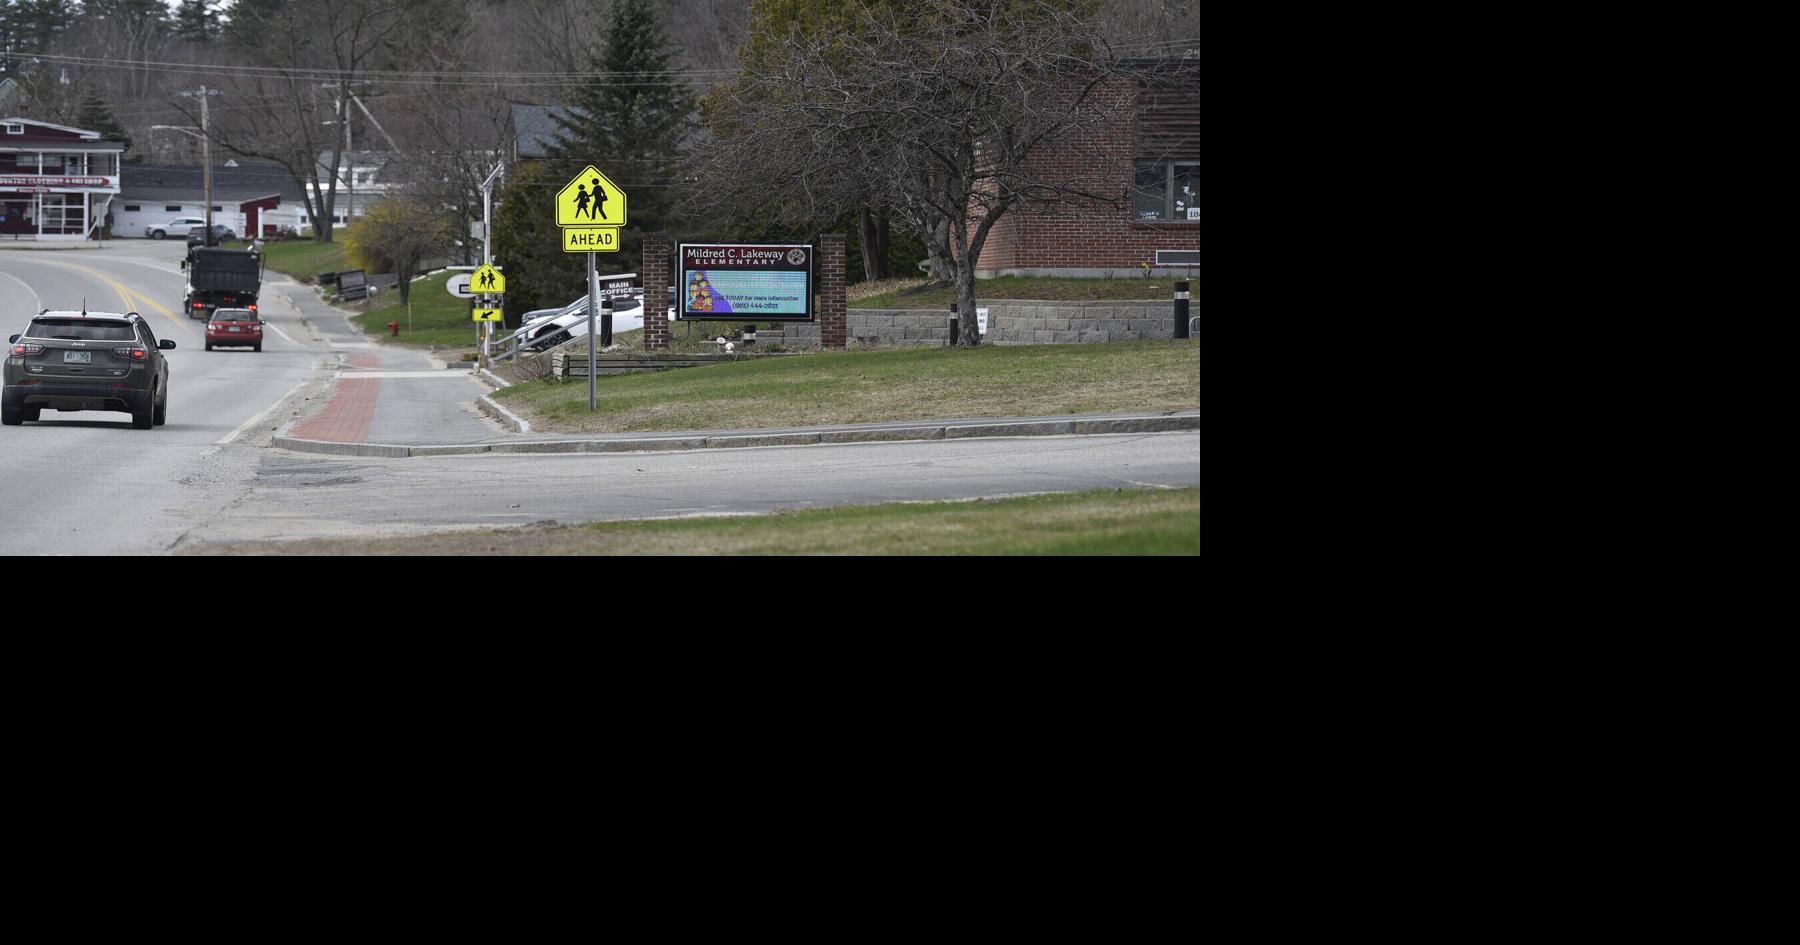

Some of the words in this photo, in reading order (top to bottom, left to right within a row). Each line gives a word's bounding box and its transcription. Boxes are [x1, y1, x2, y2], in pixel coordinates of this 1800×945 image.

[28, 177, 64, 185] CLOTHING
[570, 233, 613, 245] AHEAD
[687, 248, 725, 258] Mildred
[727, 248, 738, 258] C.
[741, 248, 785, 260] Lakeway
[608, 281, 629, 289] MAIN
[606, 287, 634, 295] OFFICE
